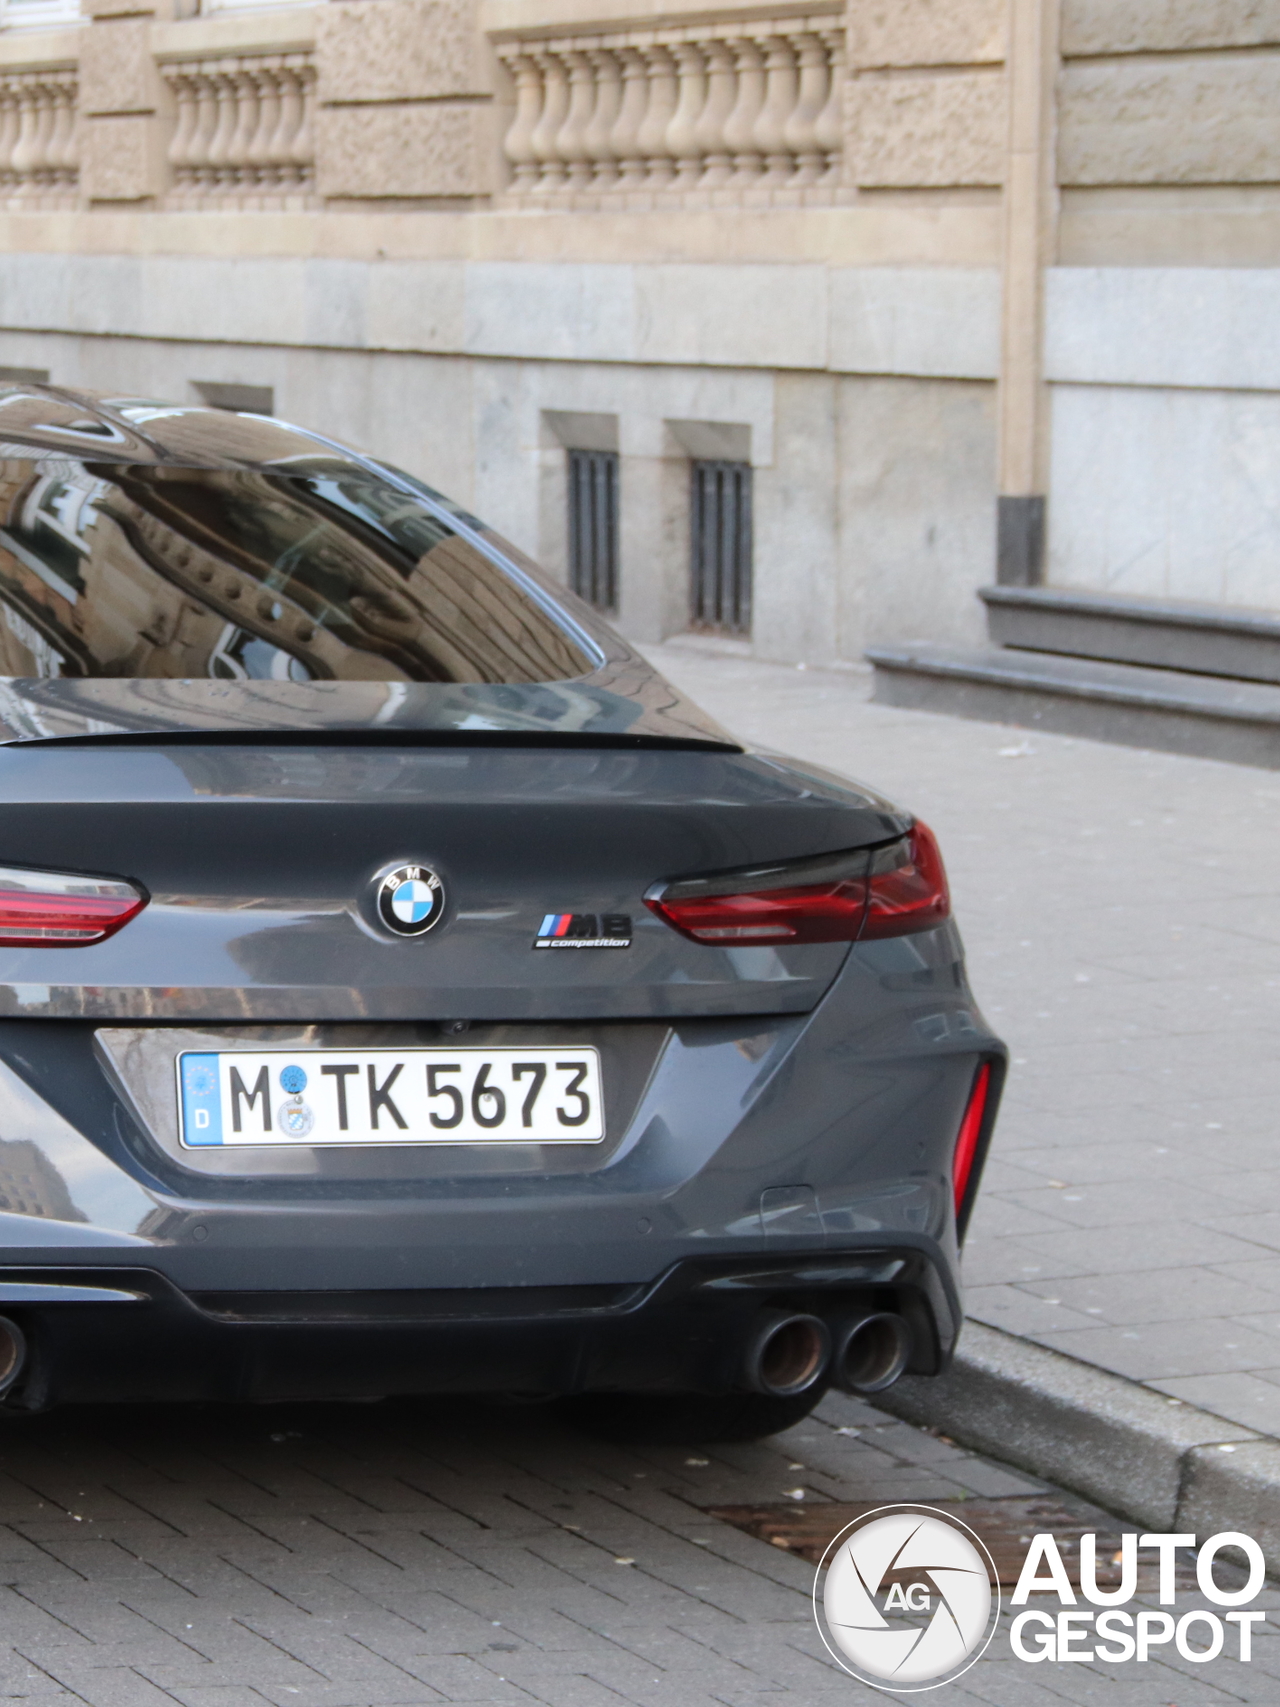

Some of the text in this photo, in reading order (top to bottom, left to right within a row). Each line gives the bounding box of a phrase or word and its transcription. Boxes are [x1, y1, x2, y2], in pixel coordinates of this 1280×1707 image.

[385, 867, 440, 890] BMW
[565, 914, 632, 937] M8
[551, 938, 630, 948] competition
[229, 1065, 273, 1132] M
[321, 1063, 409, 1130] TK
[426, 1062, 590, 1129] 5673
[195, 1109, 209, 1128] D
